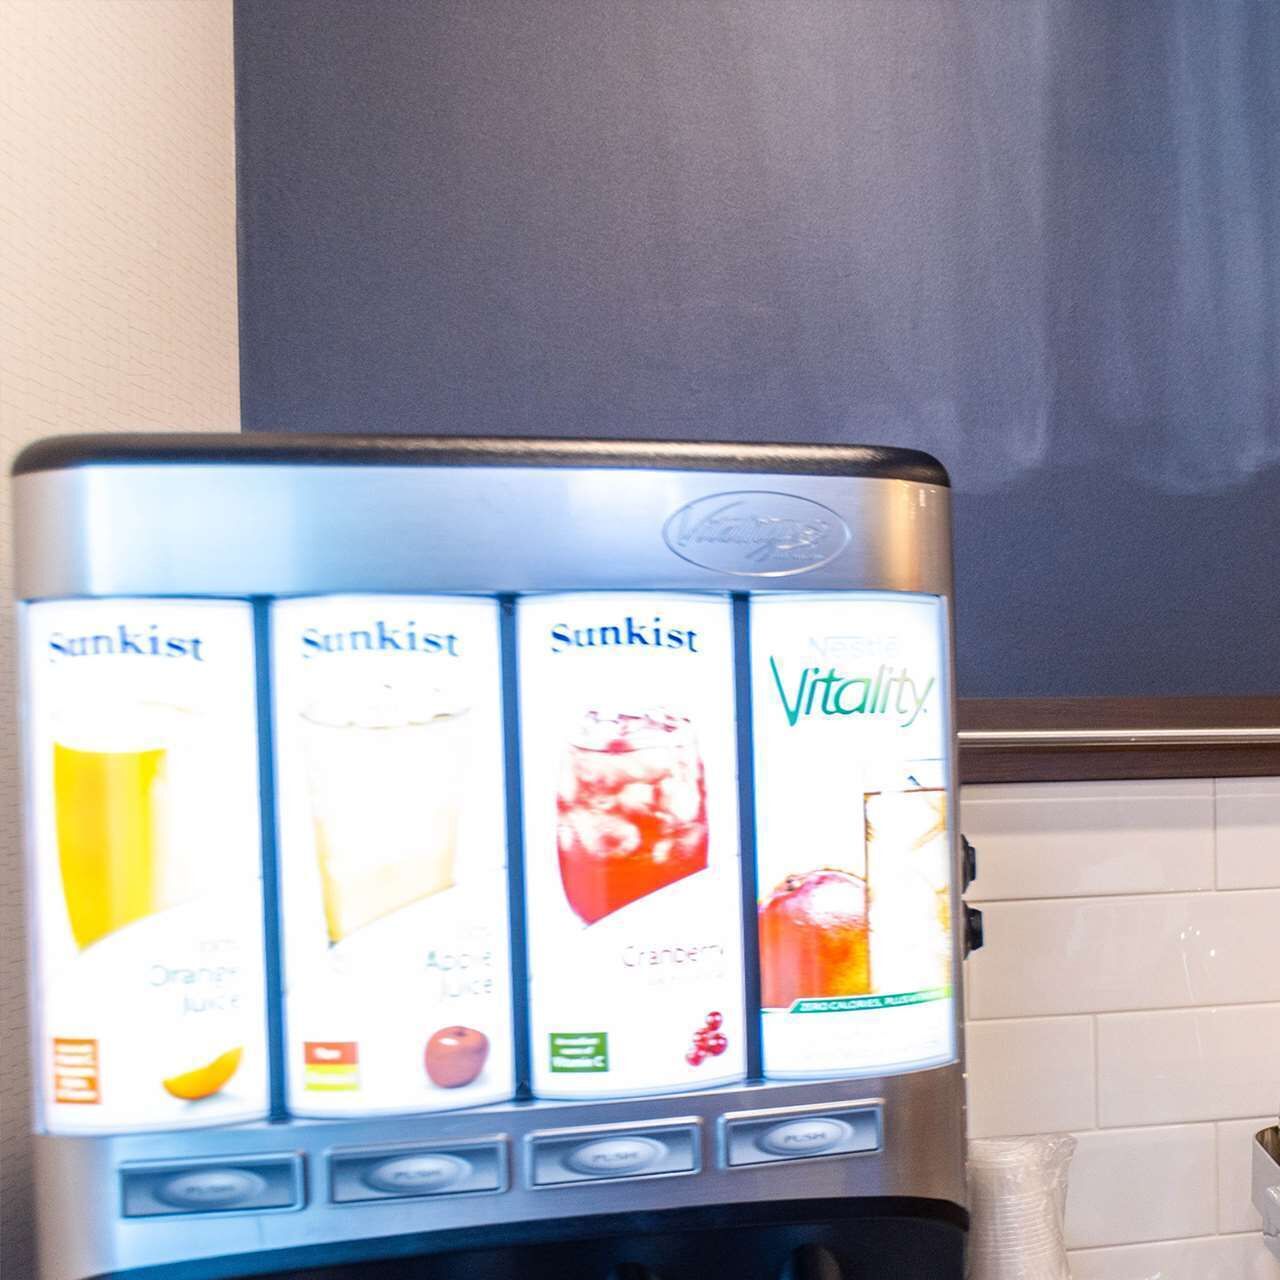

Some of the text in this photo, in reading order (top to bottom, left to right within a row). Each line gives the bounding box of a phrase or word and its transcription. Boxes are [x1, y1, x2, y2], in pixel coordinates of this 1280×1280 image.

[49, 625, 204, 662] Sunkist
[303, 621, 459, 657] Sunkist
[551, 616, 699, 653] Sunkist
[769, 654, 936, 728] Vitality
[617, 943, 729, 969] Cranberry
